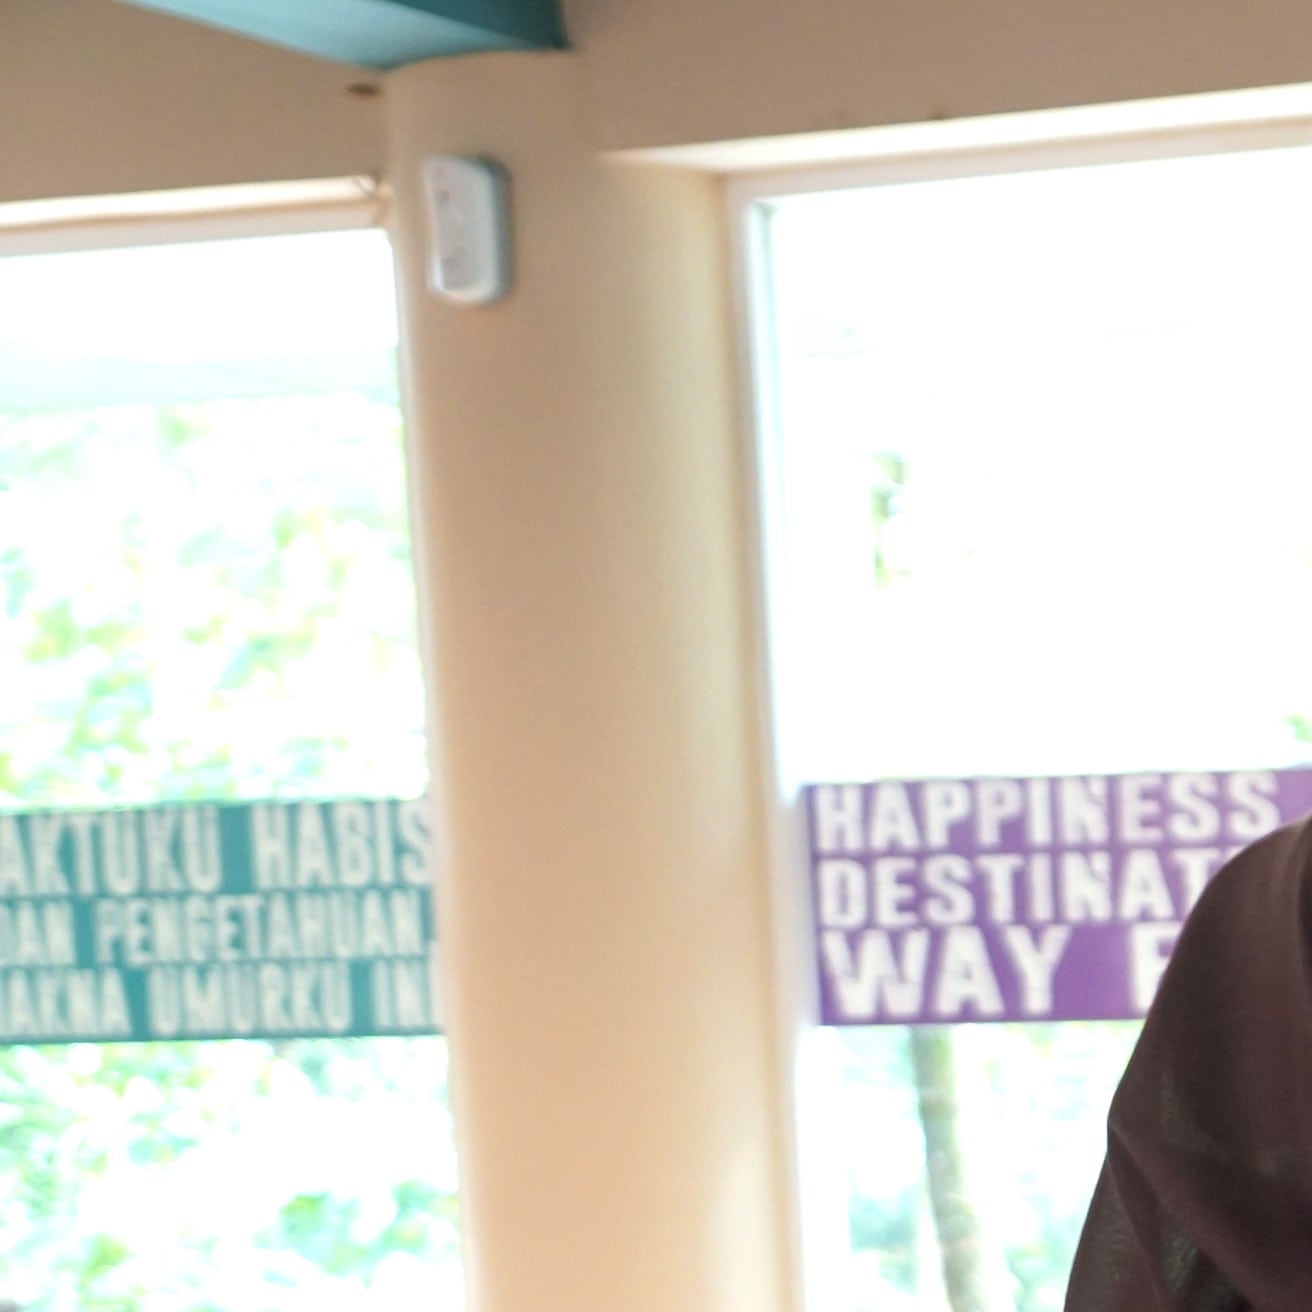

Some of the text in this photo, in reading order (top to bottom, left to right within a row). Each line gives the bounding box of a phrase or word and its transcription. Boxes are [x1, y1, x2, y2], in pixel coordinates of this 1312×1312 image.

[815, 770, 1280, 850] HAPPINESS
[819, 846, 1243, 928] DESTINAT
[821, 922, 1069, 1016] WAY
